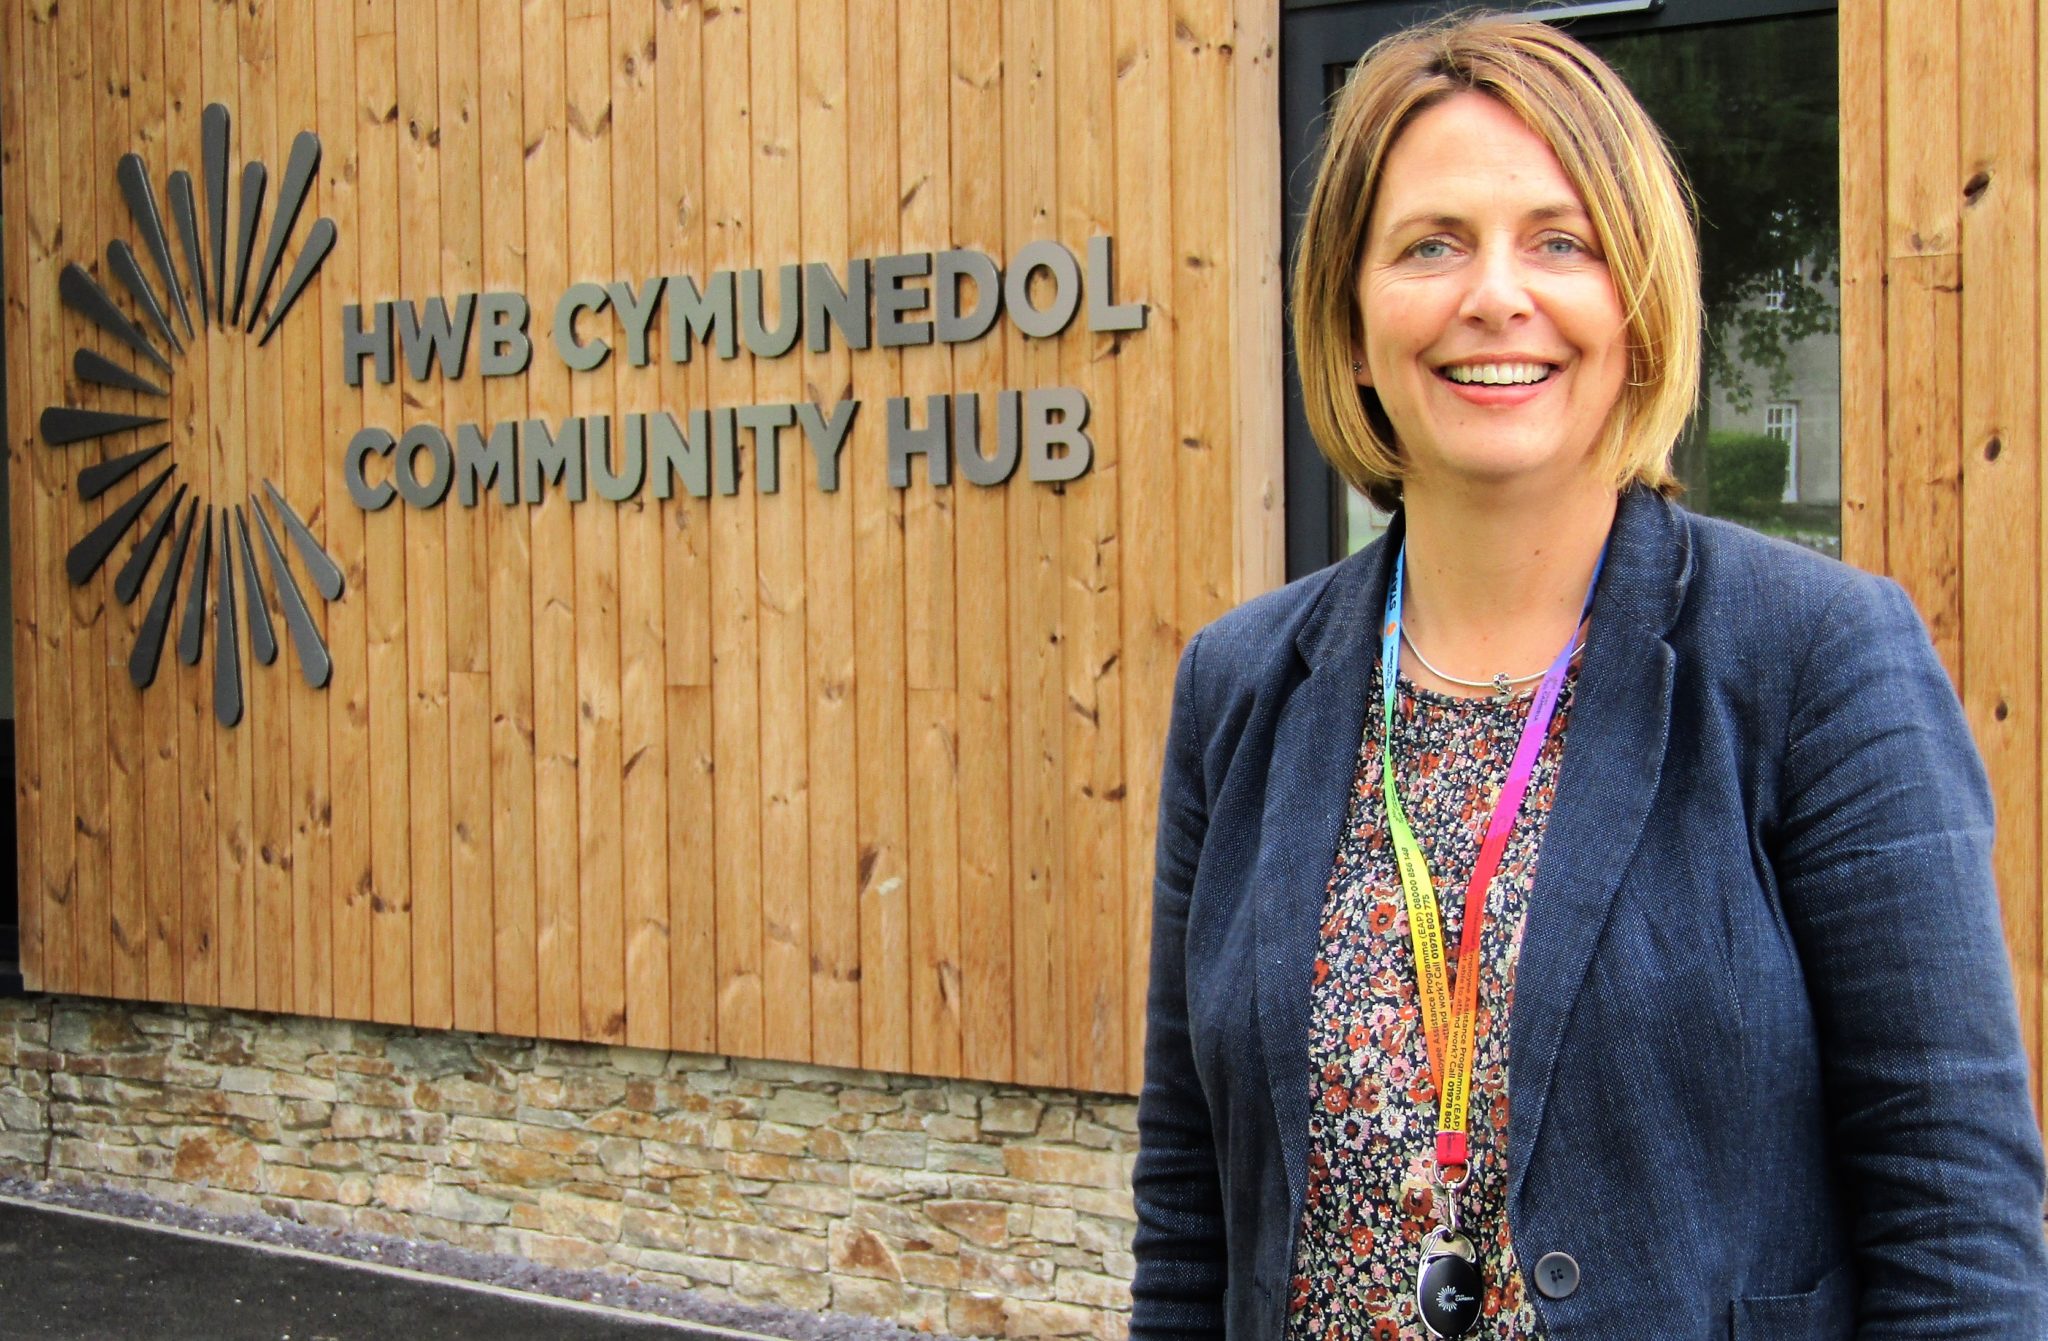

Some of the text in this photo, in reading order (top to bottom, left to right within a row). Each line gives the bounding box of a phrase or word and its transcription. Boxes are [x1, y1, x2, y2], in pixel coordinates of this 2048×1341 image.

[343, 235, 1148, 386] HWB CYMUNEDOL
[344, 387, 1095, 512] COMMUNITY HUB
[1410, 879, 1422, 910] 08000
[1422, 894, 1433, 910] 775
[1416, 912, 1428, 939] (EAP)
[1425, 911, 1436, 930] 802
[1429, 932, 1439, 960] 01978
[1422, 941, 1434, 995] Programme
[1432, 961, 1442, 979] Call
[1435, 981, 1446, 1009] work?
[1429, 996, 1441, 1044] Assistance
[1454, 997, 1464, 1028] attend
[1460, 996, 1472, 1044] Assistance
[1450, 1031, 1459, 1059] work?
[1449, 1061, 1457, 1079] Call
[1454, 1047, 1467, 1102] Programme
[1446, 1080, 1455, 1109] 01978
[1443, 1111, 1452, 1130] 802
[1452, 1103, 1462, 1131] (EAP)
